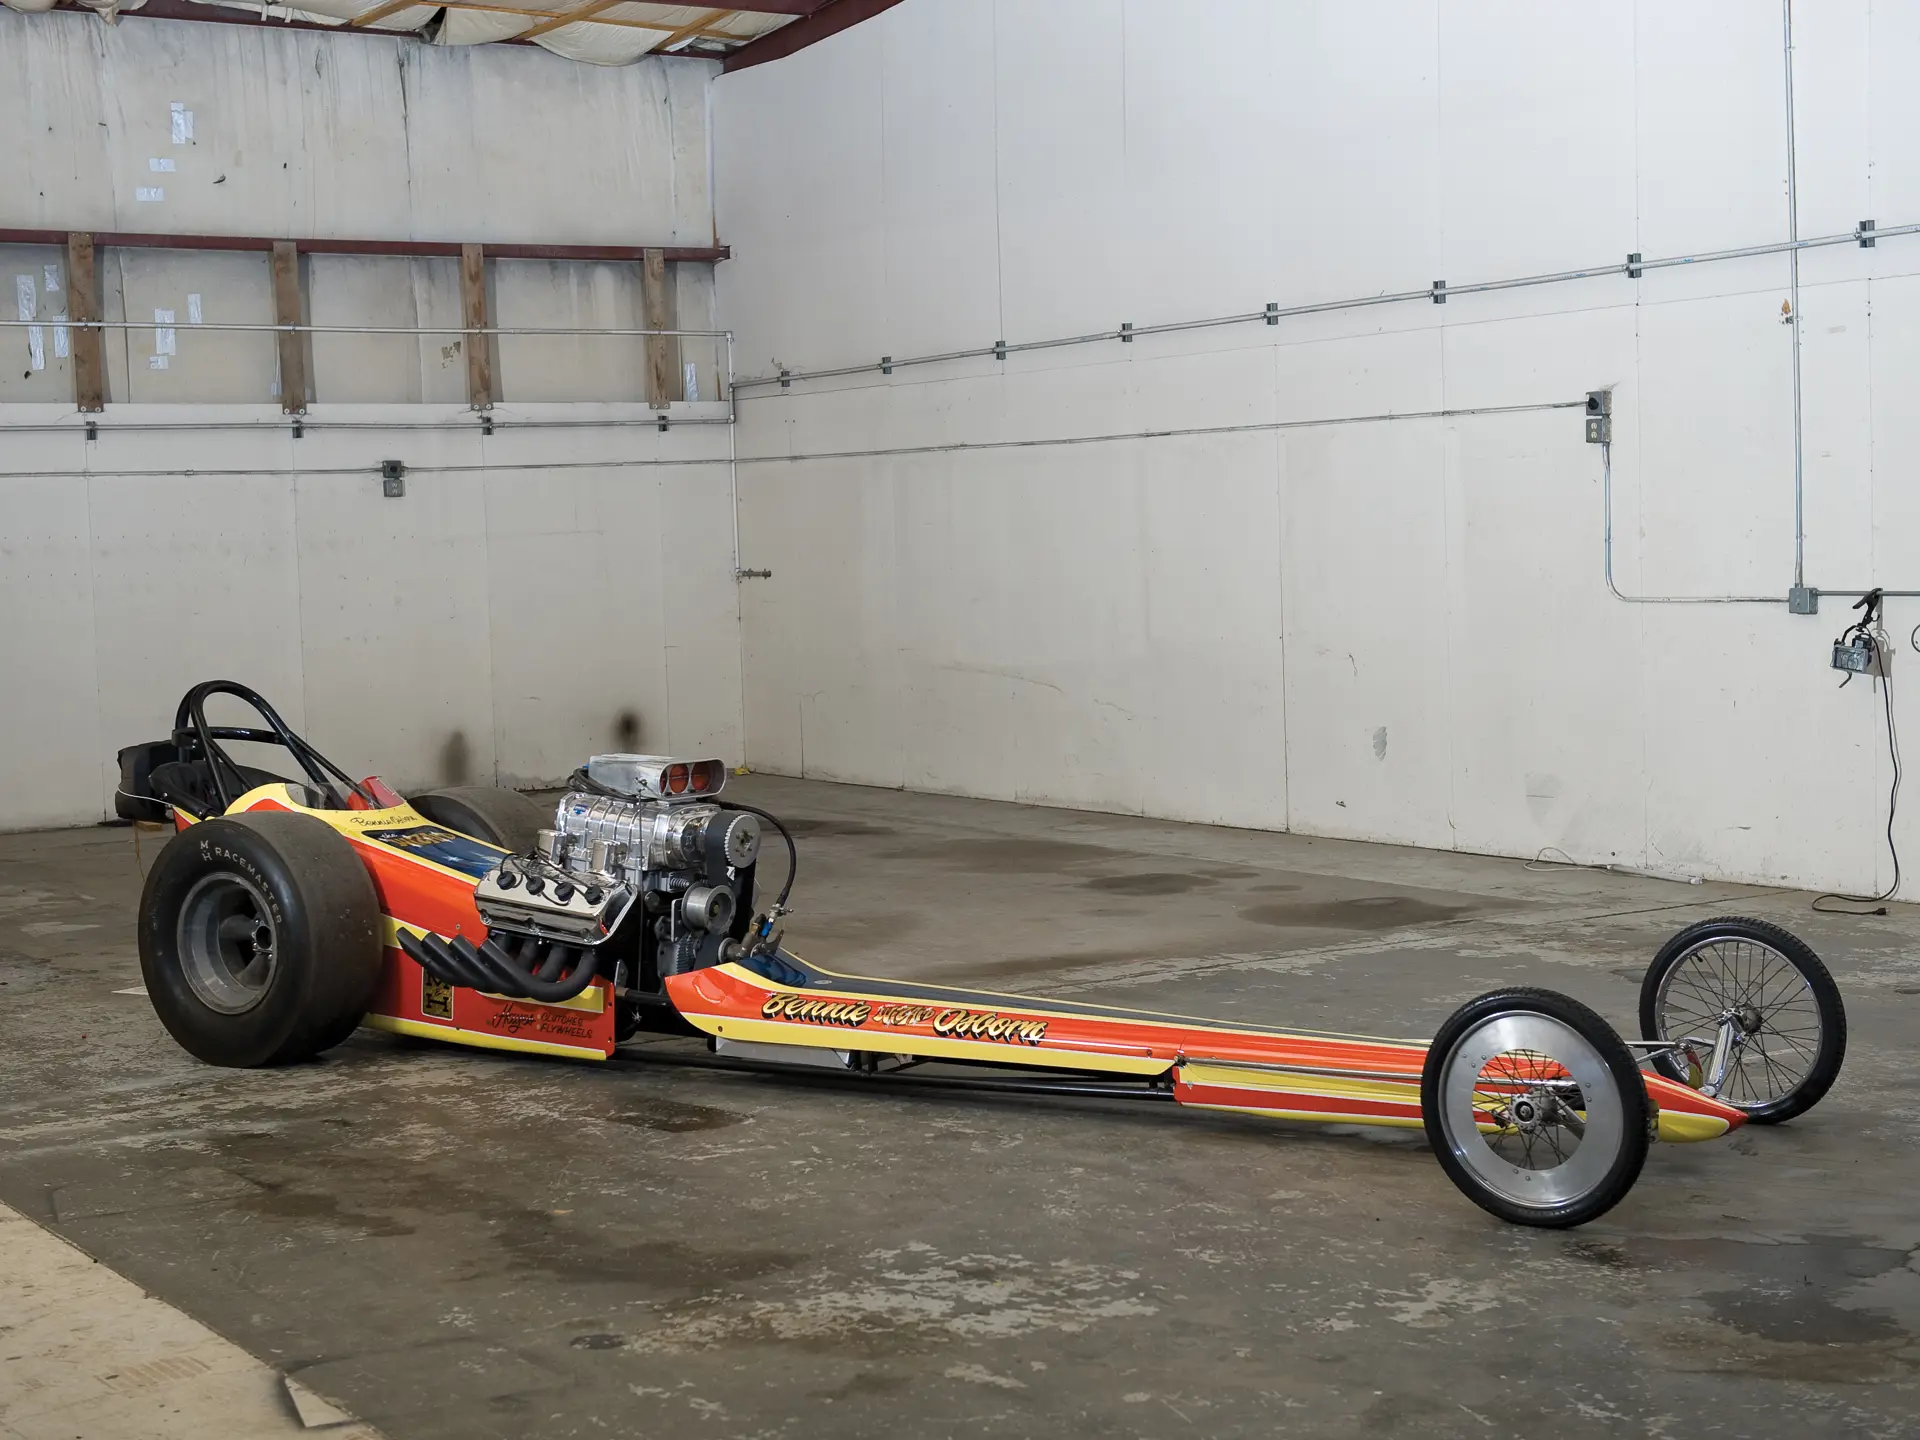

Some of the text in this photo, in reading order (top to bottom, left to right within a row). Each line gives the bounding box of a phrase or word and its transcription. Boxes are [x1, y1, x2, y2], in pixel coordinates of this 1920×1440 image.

[200, 840, 212, 861] M H
[215, 847, 282, 923] RACEMASTER
[426, 993, 449, 1012] H
[540, 1012, 583, 1027] CLUTCHES
[761, 991, 872, 1027] Bennie
[932, 1008, 1049, 1046] Osborn
[540, 1023, 593, 1038] FLYWHEELS
